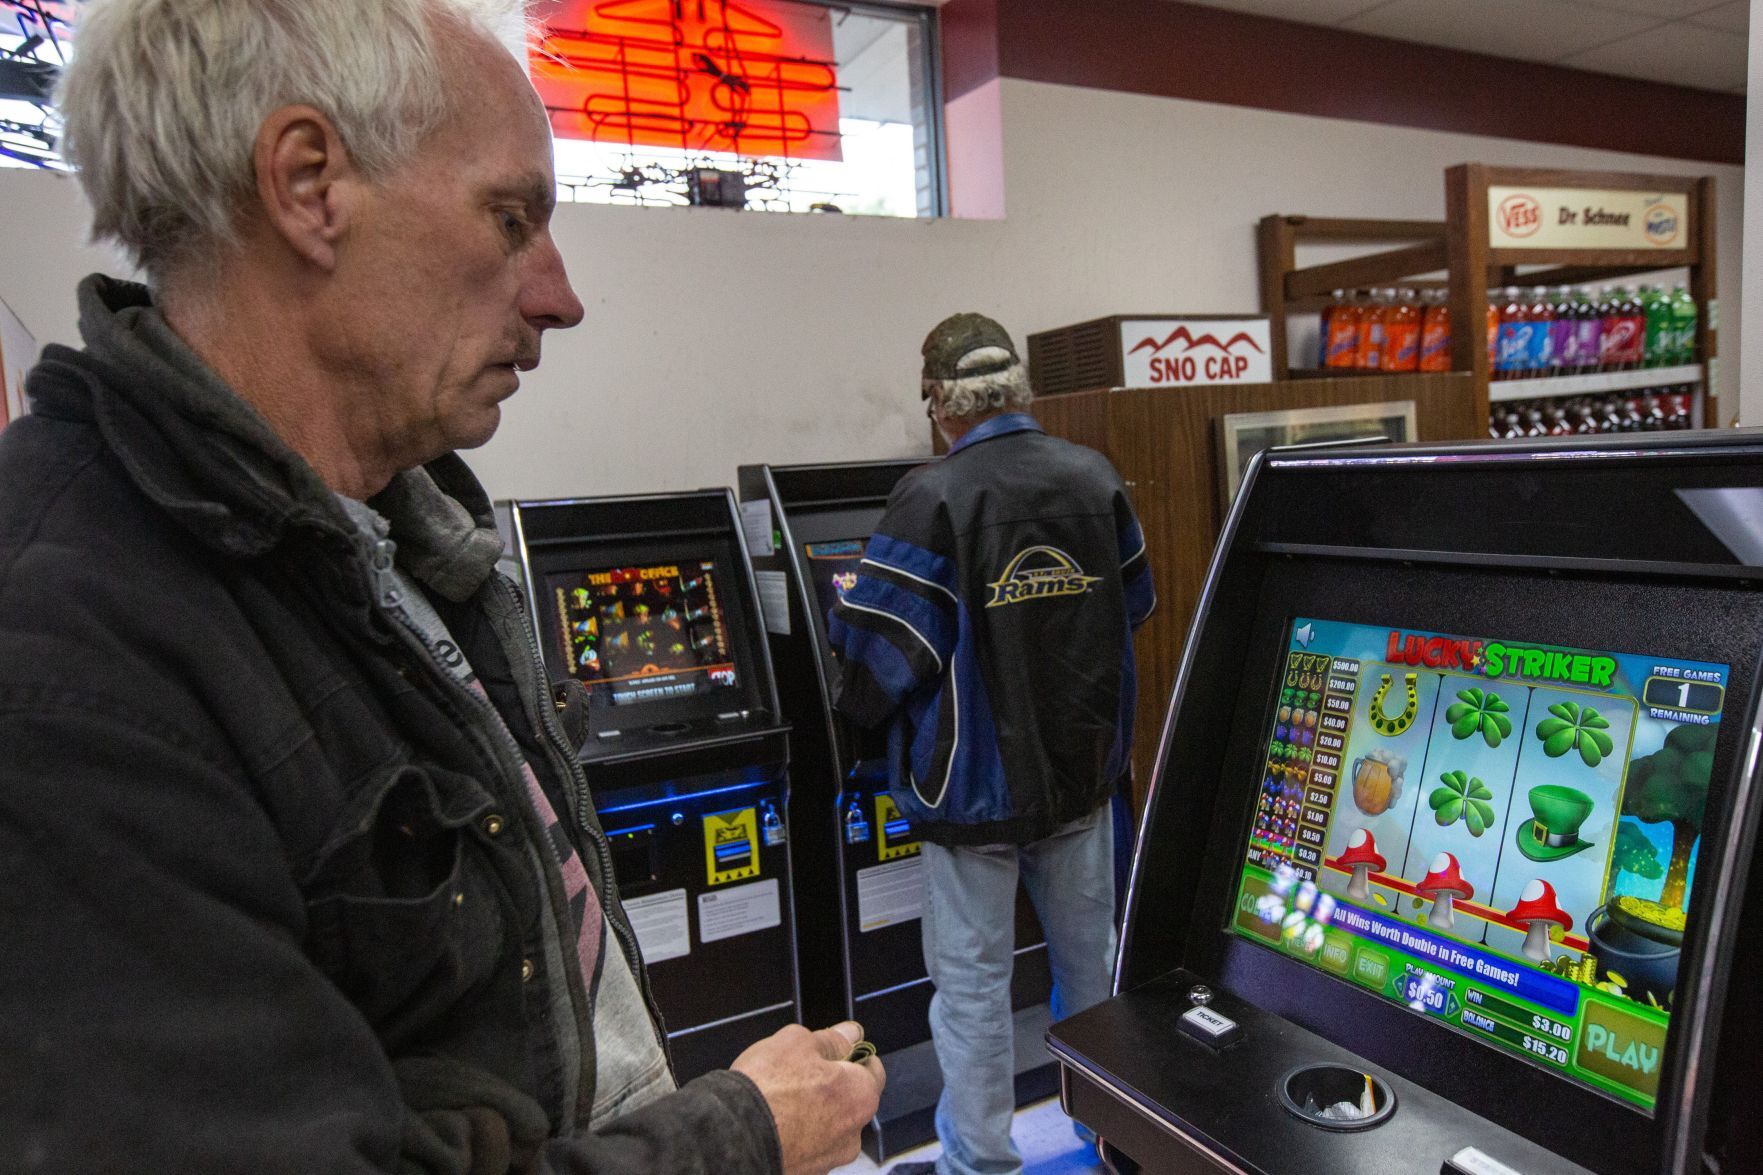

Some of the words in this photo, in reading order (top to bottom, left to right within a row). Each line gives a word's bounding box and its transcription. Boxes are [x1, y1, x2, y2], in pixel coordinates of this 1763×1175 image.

[1558, 206, 1577, 225] Dr
[1150, 356, 1196, 383] SNO
[1205, 356, 1249, 380] CAP
[986, 574, 1103, 608] Rams
[1333, 660, 1359, 673] $500.00
[1386, 631, 1482, 671] LUCKY
[1485, 643, 1617, 688] STRIKER
[1653, 666, 1680, 677] FREE
[1683, 669, 1721, 682] GAMES
[1329, 679, 1355, 691] $200.00
[1678, 683, 1690, 708] 1
[1327, 698, 1350, 711] $50.00
[1323, 716, 1346, 729] $40.00
[1650, 708, 1710, 725] REMAINING
[1320, 735, 1342, 748] $20.00
[1317, 754, 1338, 766] $10.00
[1314, 773, 1332, 785] $5.00
[1310, 792, 1328, 804] $2.50
[1306, 810, 1324, 823] $1.00
[1302, 830, 1320, 842] $0.50
[1298, 848, 1317, 861] $0.30
[1324, 943, 1347, 963] INFO
[1333, 908, 1346, 922] All
[1347, 913, 1370, 931] Wins
[1372, 920, 1401, 942] Worth
[1401, 932, 1437, 956] Double
[1438, 945, 1450, 961] in
[1450, 950, 1474, 970] Free
[1475, 959, 1520, 987] Games!
[1358, 957, 1385, 978] EXIT
[1405, 963, 1425, 977] PLAY
[1425, 971, 1456, 989] MOUNT
[1408, 982, 1443, 1009] $0.50
[1466, 989, 1483, 1004] WIN
[1197, 1011, 1224, 1026] TICKET
[1463, 1010, 1495, 1032] BALANCE
[1532, 1015, 1571, 1041] $3.00
[1522, 1035, 1568, 1065] $15.20
[1585, 1023, 1658, 1074] PLAY
